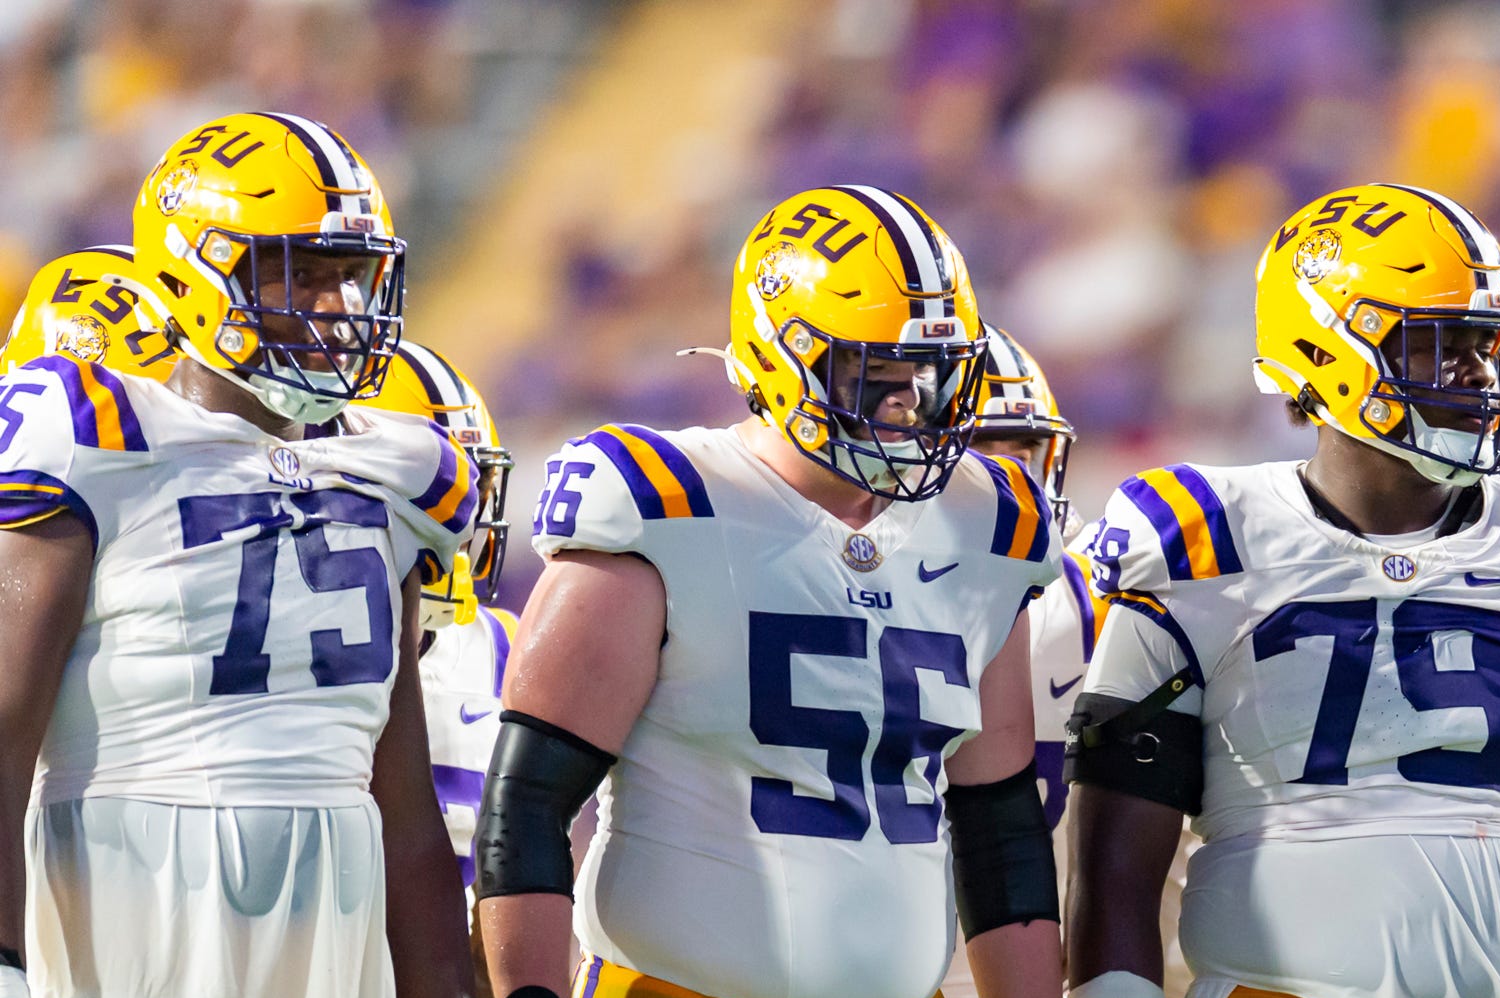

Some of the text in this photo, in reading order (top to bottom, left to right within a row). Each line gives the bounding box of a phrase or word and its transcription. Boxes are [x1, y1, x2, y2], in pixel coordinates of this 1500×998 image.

[342, 216, 375, 233] LSU
[921, 322, 956, 338] LSU
[0, 383, 48, 454] 5
[1002, 400, 1036, 416] LSU
[848, 535, 876, 562] SEC
[1383, 555, 1415, 580] SEC
[177, 491, 394, 695] 75
[846, 587, 893, 609] LSU
[748, 610, 972, 845] 56
